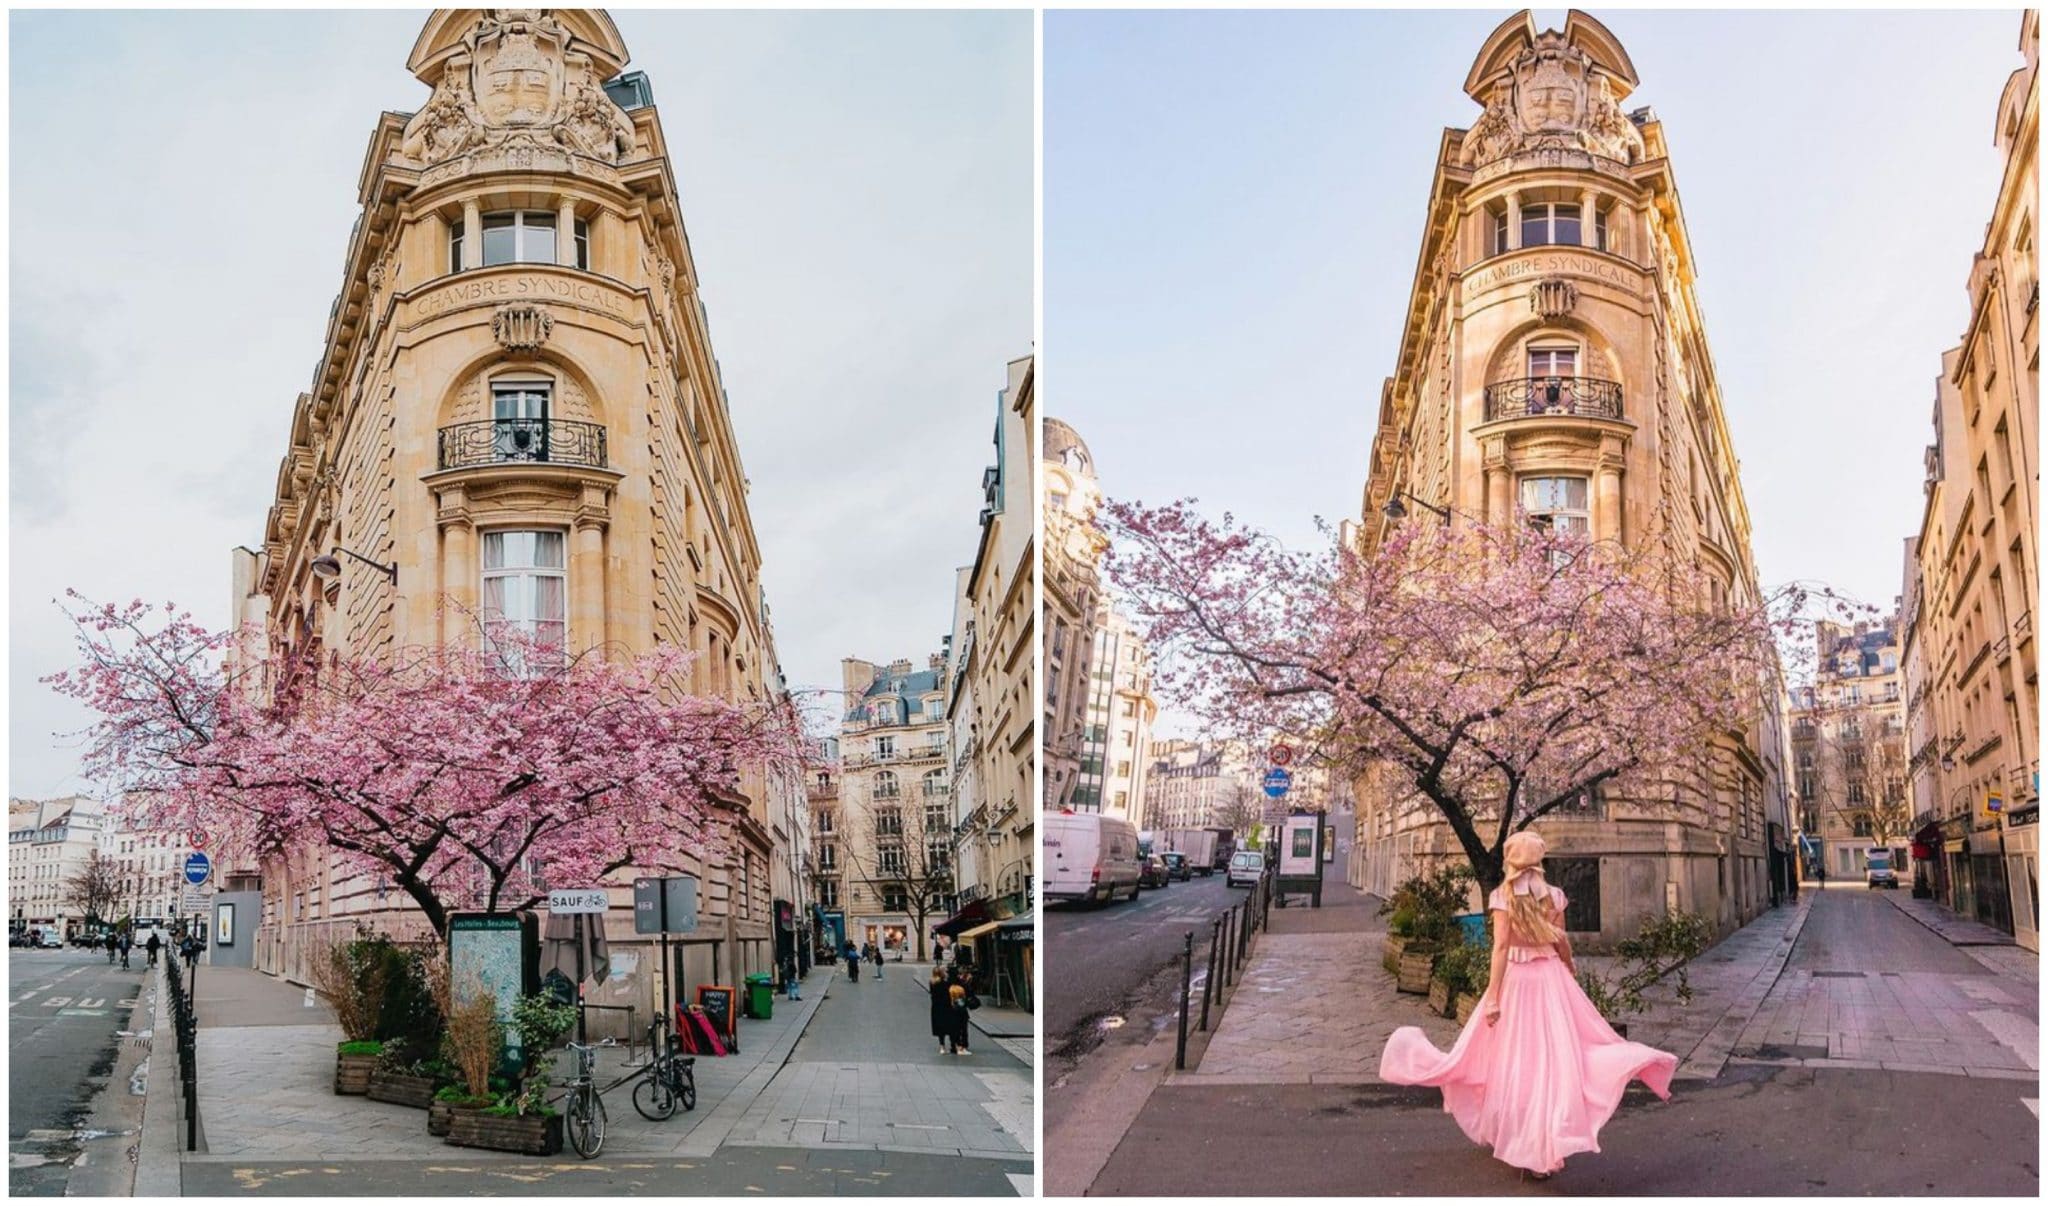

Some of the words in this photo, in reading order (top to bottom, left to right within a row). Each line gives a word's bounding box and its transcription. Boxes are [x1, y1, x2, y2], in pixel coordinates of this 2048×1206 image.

[1468, 256, 1543, 291] CHAMBRE
[1548, 255, 1641, 288] SYNDICALE
[416, 276, 510, 316] CHAMBRE
[516, 276, 625, 312] SYNDICALE
[194, 833, 203, 843] 30
[552, 896, 584, 908] SAUF
[487, 919, 520, 929] Beaubourg
[41, 996, 140, 1009] BUS
